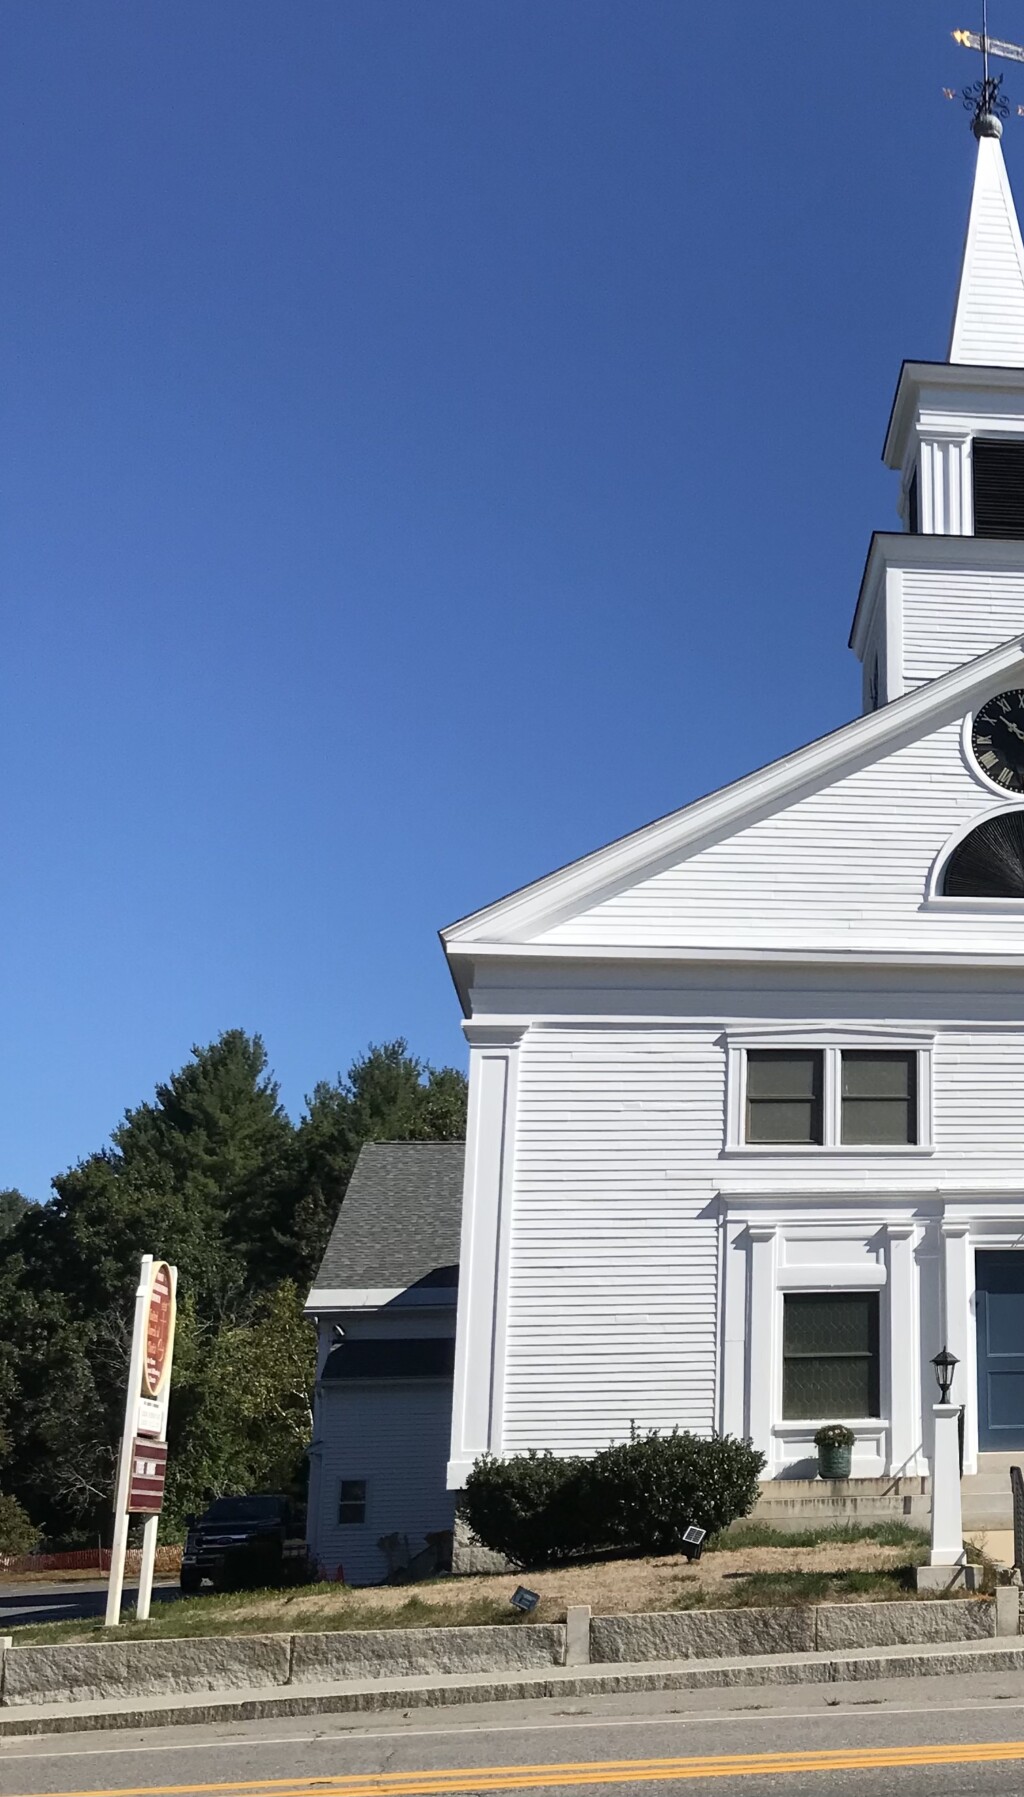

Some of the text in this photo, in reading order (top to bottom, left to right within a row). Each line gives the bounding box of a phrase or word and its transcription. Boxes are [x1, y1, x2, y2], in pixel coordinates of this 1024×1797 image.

[996, 698, 1012, 714] XI
[981, 713, 998, 726] X
[976, 735, 992, 745] IX
